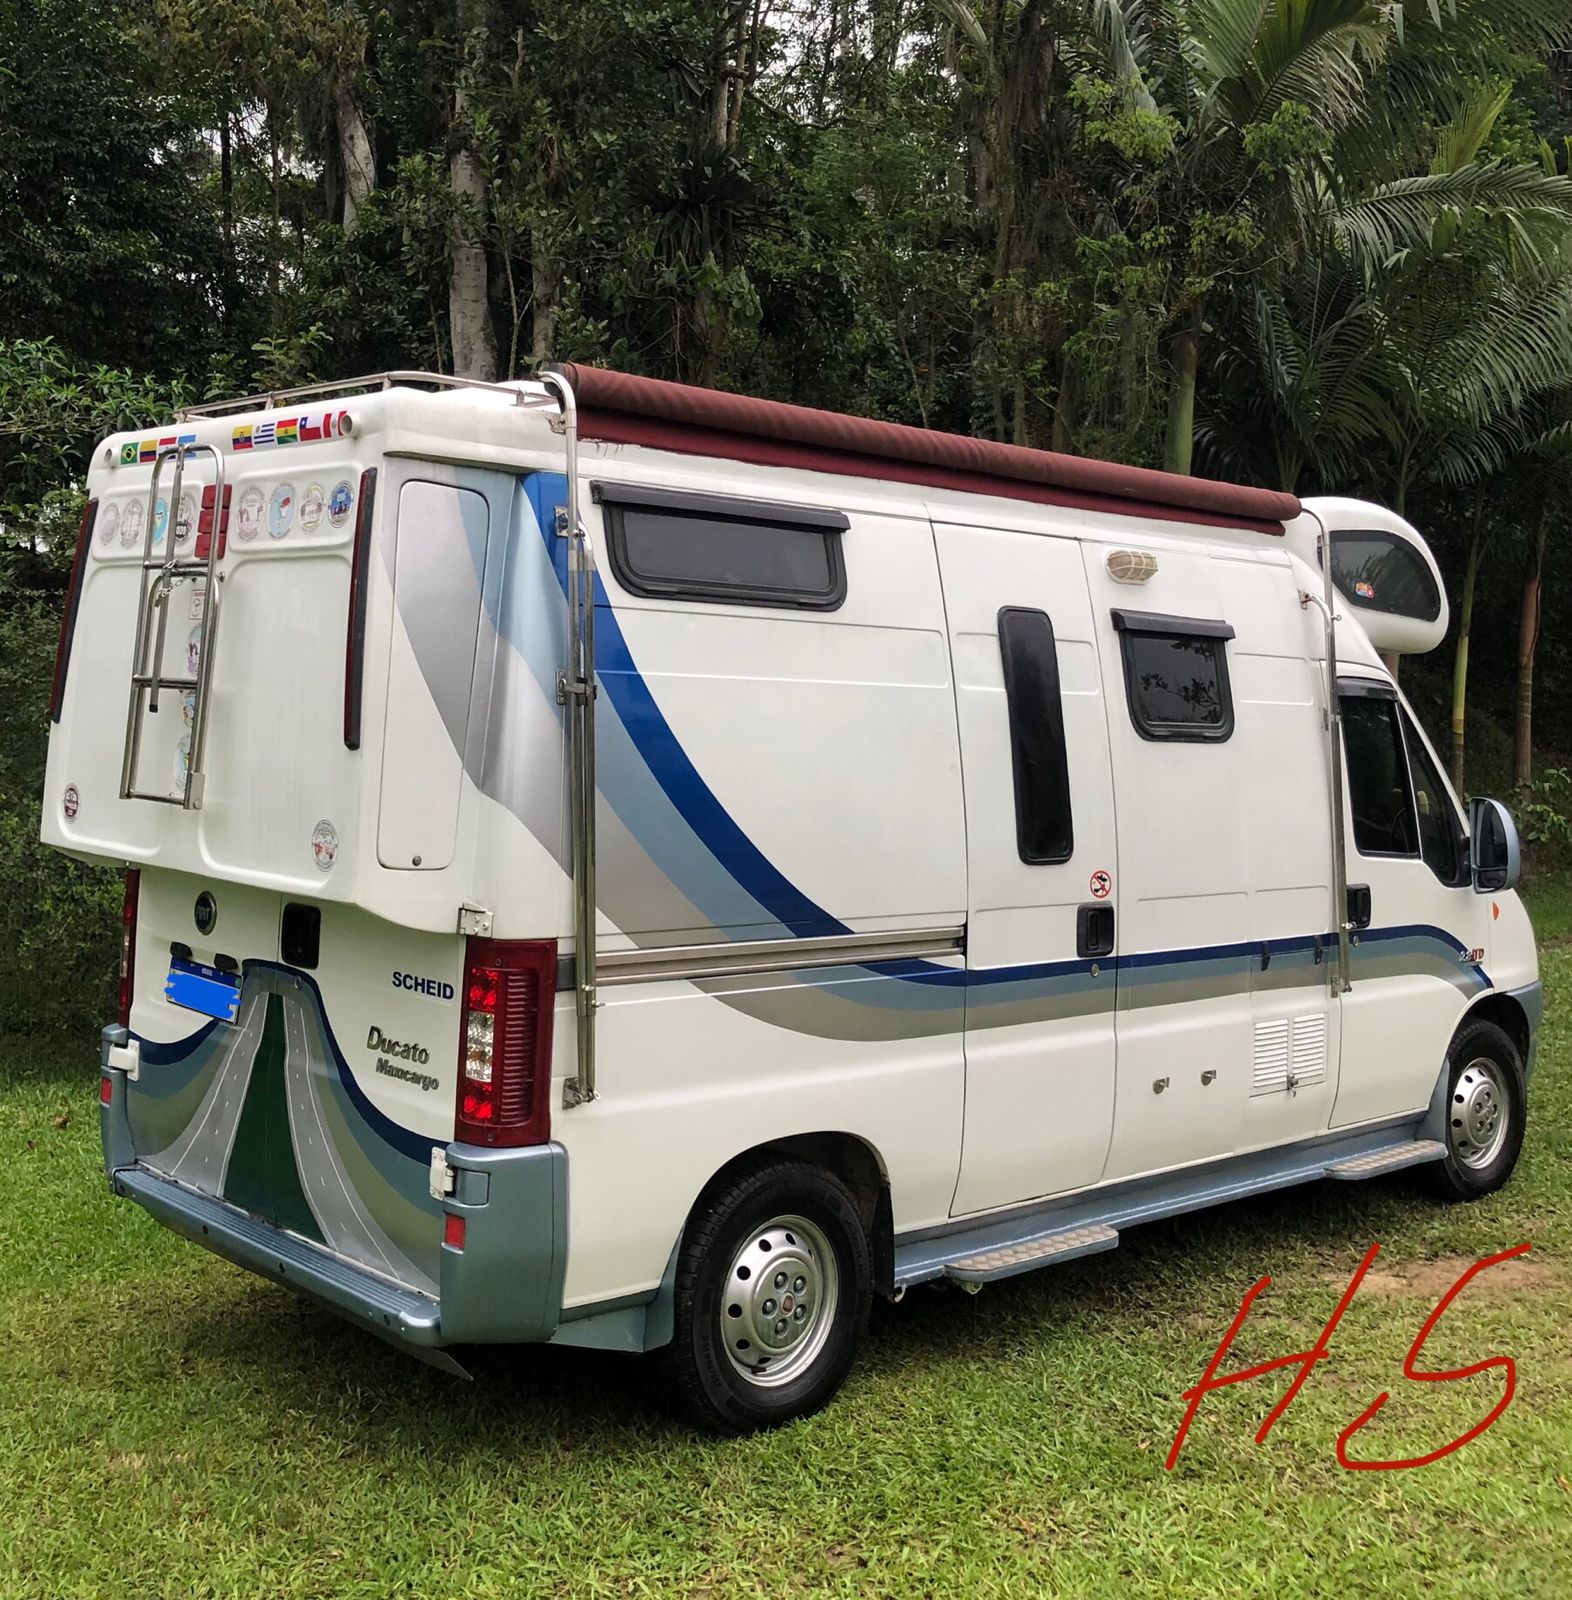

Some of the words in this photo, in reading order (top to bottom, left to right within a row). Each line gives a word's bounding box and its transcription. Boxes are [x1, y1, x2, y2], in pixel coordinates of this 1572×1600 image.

[392, 971, 454, 1000] SCHEID
[366, 1025, 430, 1065] Ducato
[375, 1057, 440, 1092] Maxicargo
